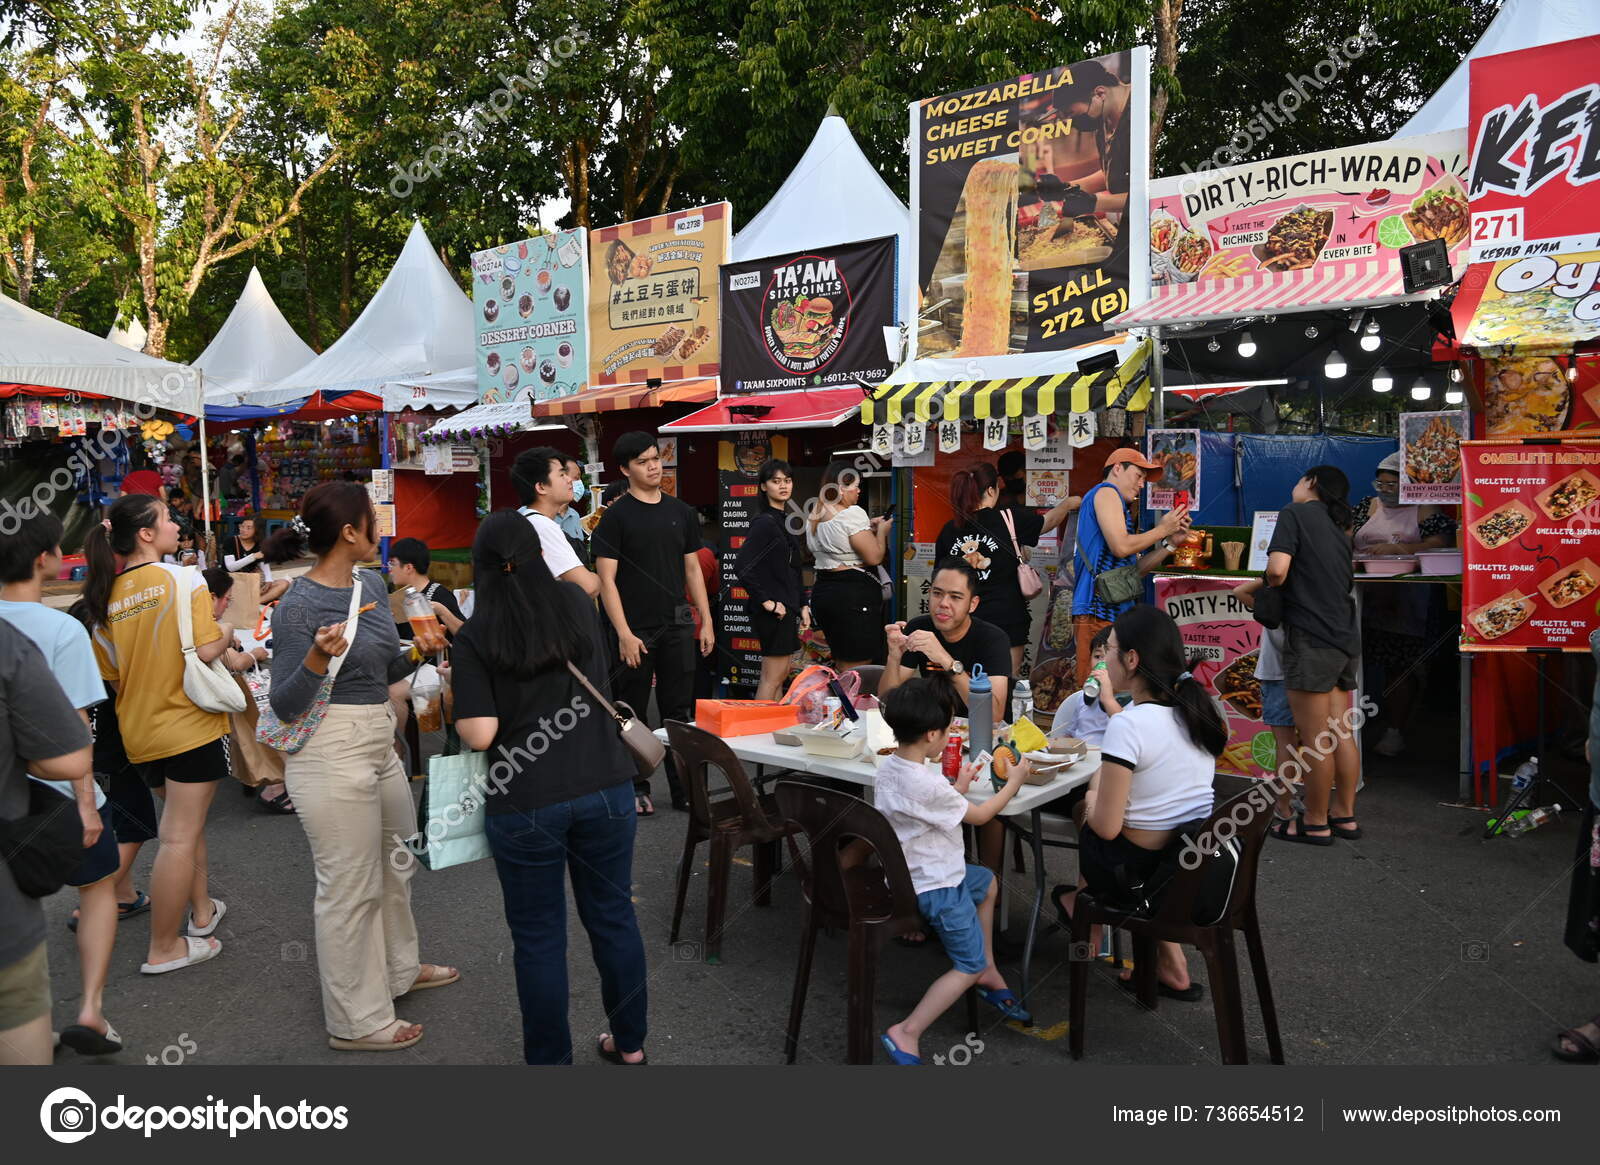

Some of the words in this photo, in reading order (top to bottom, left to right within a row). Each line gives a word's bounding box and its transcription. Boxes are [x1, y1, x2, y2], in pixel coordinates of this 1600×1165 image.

[925, 69, 1074, 120] MOZZARELLA
[925, 109, 1009, 142] CHEESE
[925, 135, 1002, 165] SWEET
[1006, 119, 1073, 148] CORN
[1184, 154, 1422, 218] DIRTY-RICH-WRAP
[1231, 222, 1252, 232] TASTE
[1253, 220, 1265, 229] THE
[1473, 213, 1518, 240] 271
[1222, 232, 1265, 247] RICHNESS
[1336, 233, 1347, 243] IN
[1323, 246, 1352, 259] EVERY
[1353, 244, 1373, 256] BITE
[1479, 245, 1521, 261] KEBAB
[1523, 240, 1561, 258] AYAM
[476, 260, 503, 273] NO274A
[734, 275, 759, 287] NO273A
[1495, 255, 1600, 299] Oy
[769, 280, 842, 300] SIXPOINTS
[1032, 268, 1112, 314] STALL
[1040, 308, 1086, 339] 272
[1091, 287, 1128, 323] (B)
[480, 326, 527, 346] DESSERT
[528, 319, 576, 339] CORNER
[866, 368, 887, 379] 9692
[766, 377, 806, 388] SIXPOINTS
[1555, 452, 1600, 465] MENU
[1517, 477, 1546, 485] OYSTER
[723, 604, 743, 612] AYAM
[723, 614, 750, 622] DAGING
[724, 624, 751, 633] CAMPUR
[1542, 627, 1575, 635] SPECIAL
[1184, 634, 1206, 643] TASTE
[1207, 635, 1221, 643] THE
[1183, 646, 1220, 659] CHNESS
